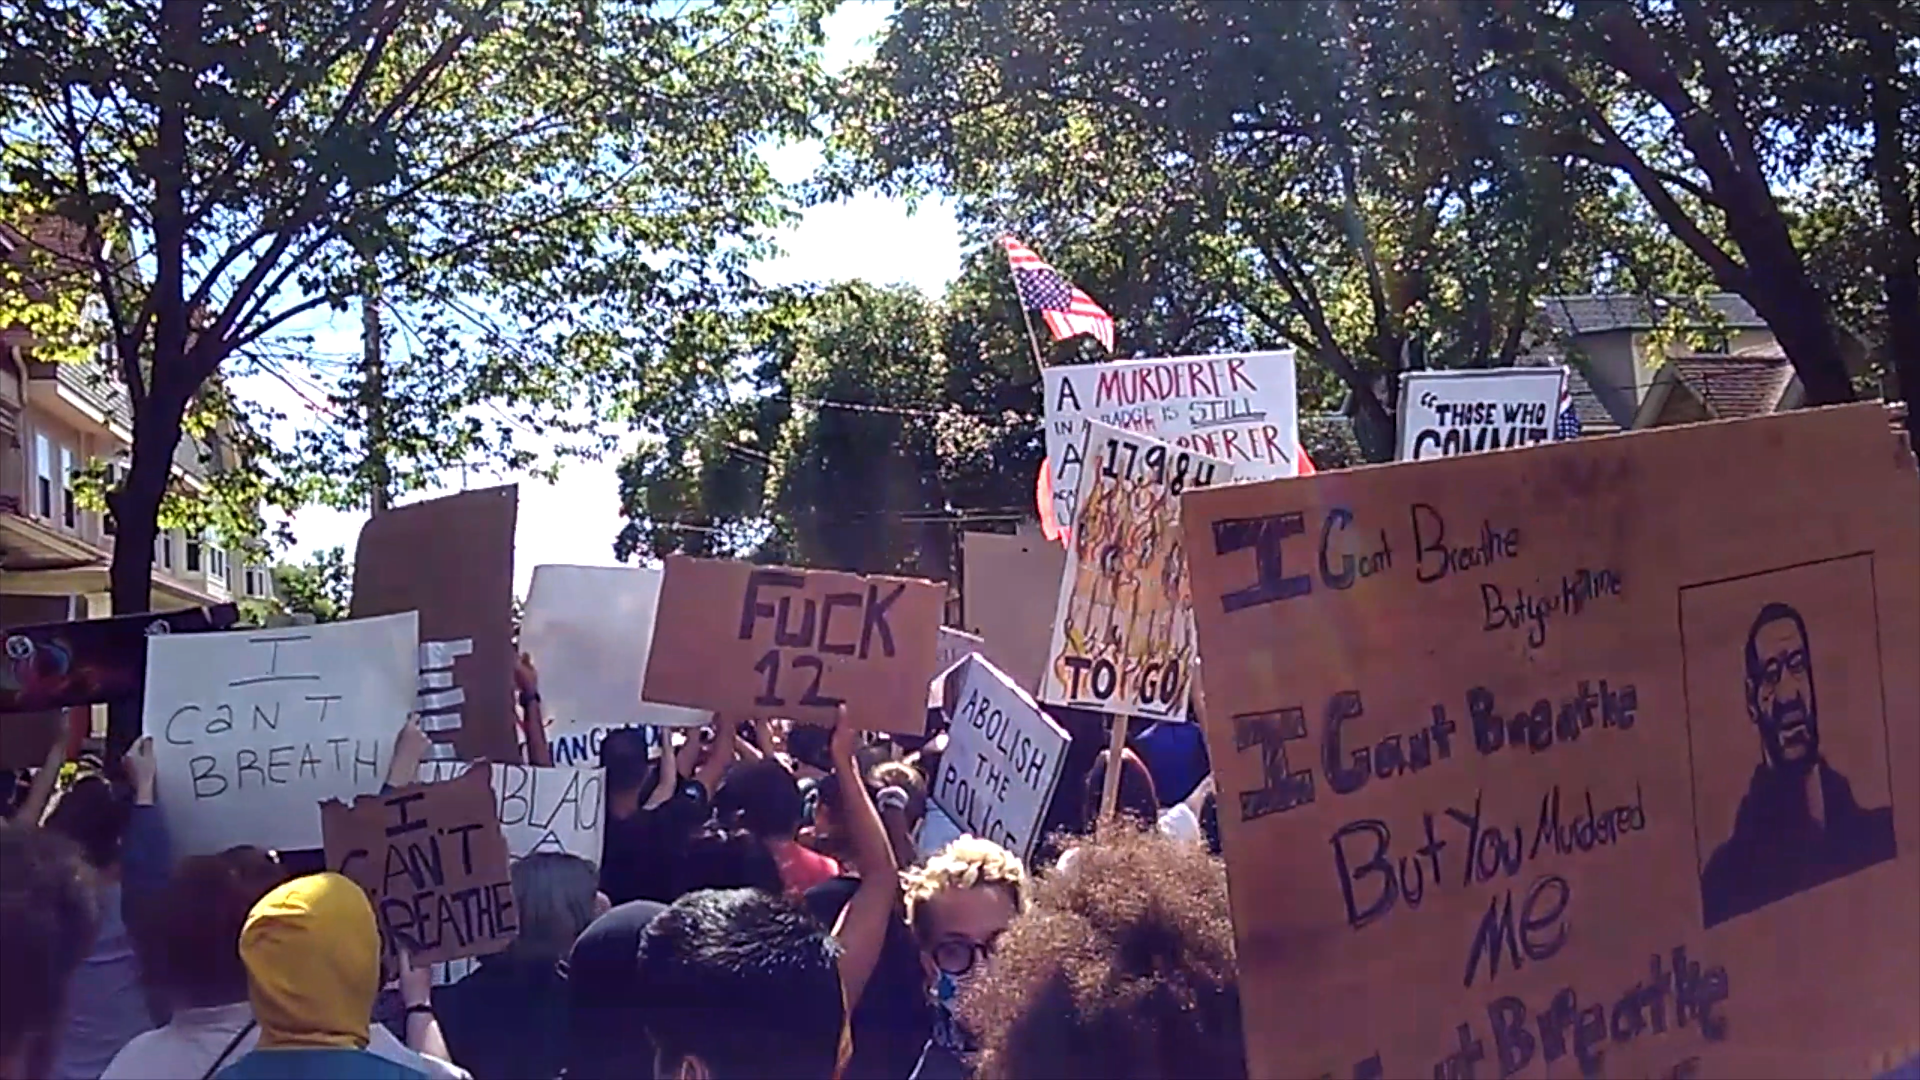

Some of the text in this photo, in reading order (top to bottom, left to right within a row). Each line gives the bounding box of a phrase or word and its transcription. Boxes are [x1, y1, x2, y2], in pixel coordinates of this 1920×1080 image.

[1057, 358, 1257, 411] A MURDERER
[1163, 404, 1178, 420] IS
[1189, 398, 1253, 423] STILL
[1503, 402, 1546, 426] WHO
[1212, 511, 1312, 613] I
[229, 635, 320, 686] I
[753, 649, 845, 707] 12
[1065, 656, 1179, 704] TO GO
[961, 689, 1047, 791] ABOLISH
[1232, 705, 1315, 822] I
[190, 738, 378, 798] BREATH
[975, 752, 1010, 803] THE
[385, 792, 428, 838] I
[380, 882, 517, 956] REATHE
